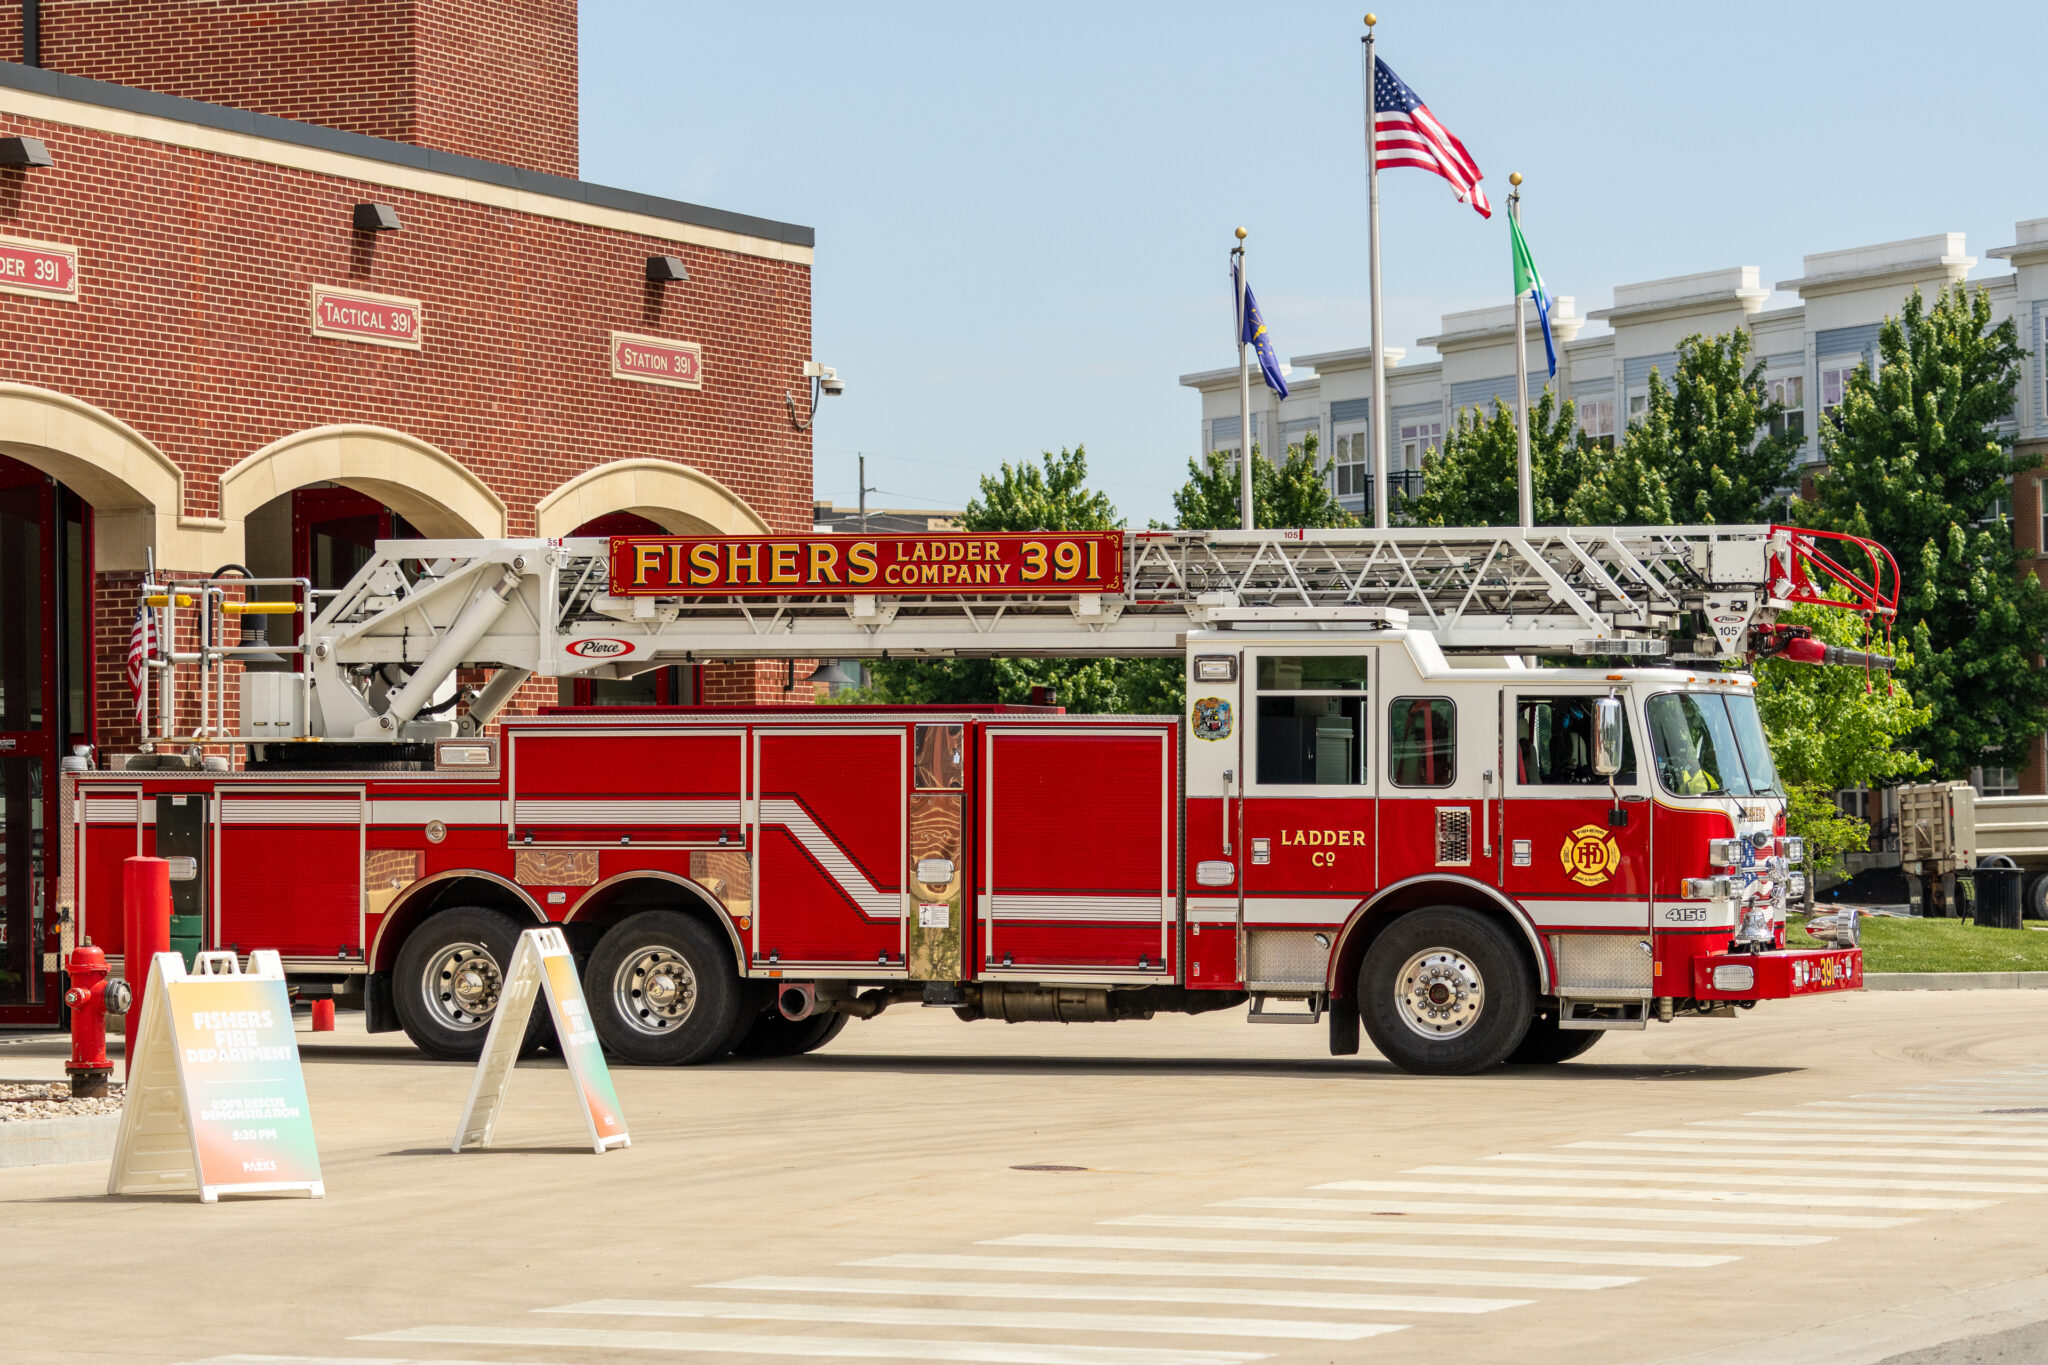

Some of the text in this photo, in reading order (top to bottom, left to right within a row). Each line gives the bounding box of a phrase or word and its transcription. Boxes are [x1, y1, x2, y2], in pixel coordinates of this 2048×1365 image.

[34, 258, 60, 282] 391
[324, 302, 411, 333] TACTICAL 391
[624, 348, 691, 375] STATION 391
[547, 539, 558, 547] 55
[1283, 531, 1299, 539] 105
[896, 541, 1002, 562] LADDER
[631, 542, 879, 586] FISHERS
[1020, 540, 1102, 583] 391
[884, 564, 1012, 585] COMPANY
[580, 641, 620, 655] Pierce
[1280, 829, 1367, 847] LADDER
[1665, 907, 1707, 921] 4156
[1820, 956, 1836, 988] 391
[192, 1010, 274, 1030] FISHERS
[214, 1029, 259, 1047] FIRE
[186, 1046, 292, 1063] DEPARTMENT
[201, 1106, 300, 1121] DEMONSTRATION
[233, 1128, 277, 1141] 5:30 PM
[243, 1160, 277, 1172] PARKS
